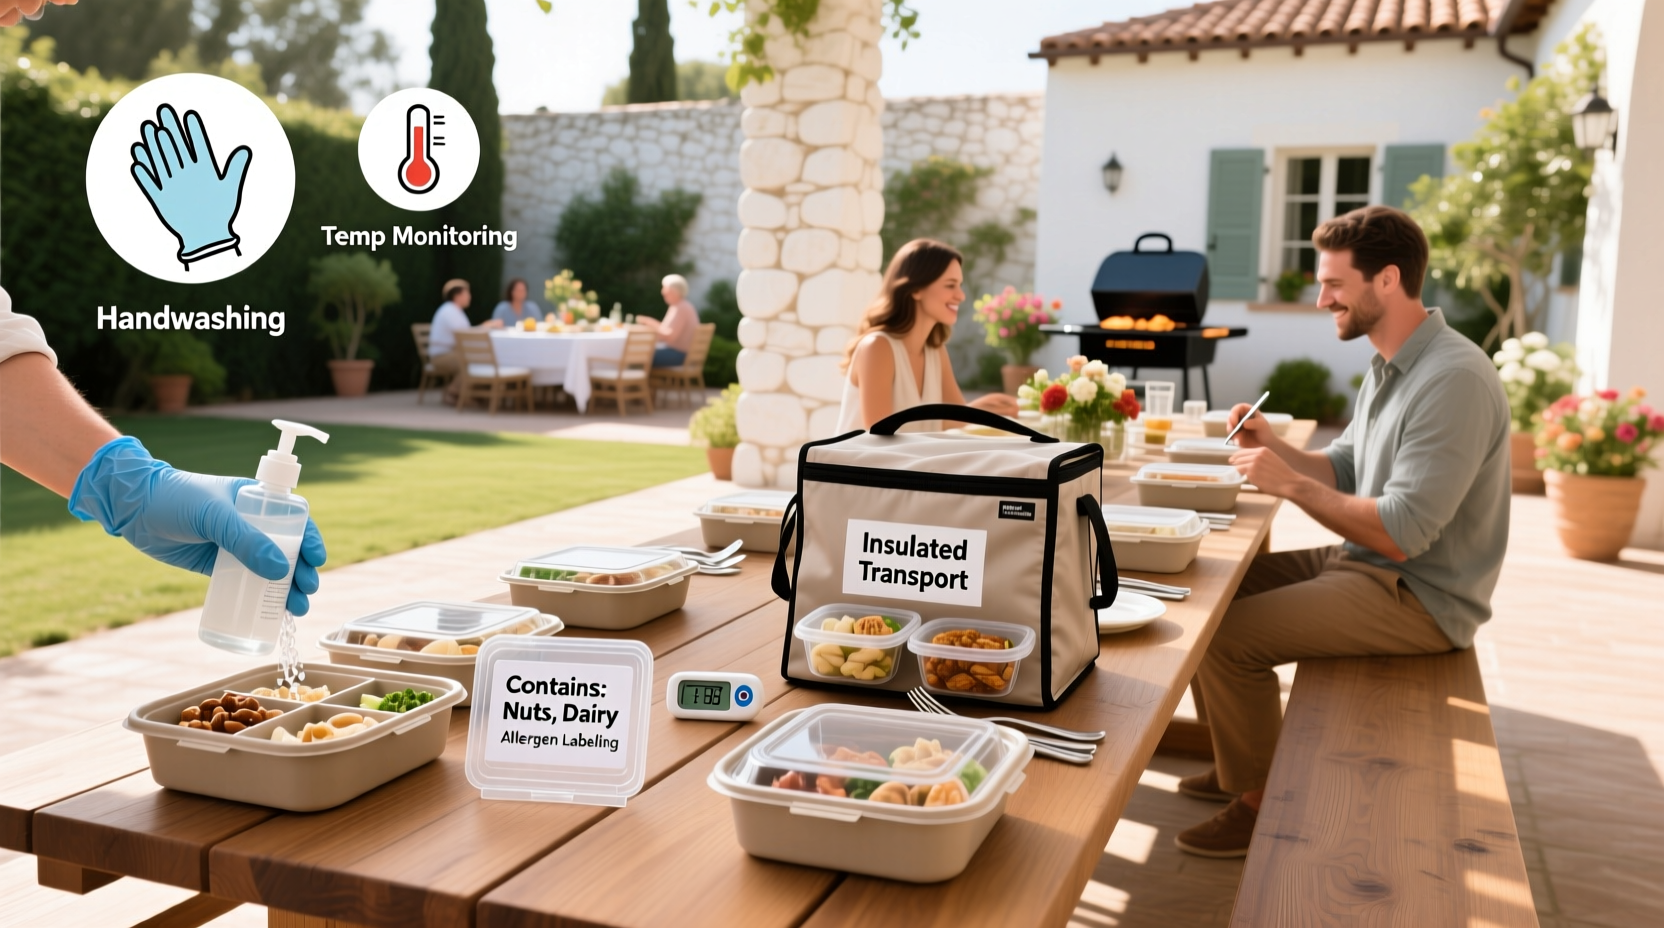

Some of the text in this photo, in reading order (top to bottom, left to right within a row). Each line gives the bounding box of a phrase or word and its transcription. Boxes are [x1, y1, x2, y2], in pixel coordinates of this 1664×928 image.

[863, 532, 968, 560] Insulated
[859, 560, 969, 592] Transport
[506, 675, 607, 698] Contains:
[503, 702, 619, 729] Nuts, Dairy
[501, 730, 619, 752] Allergen Labeling
